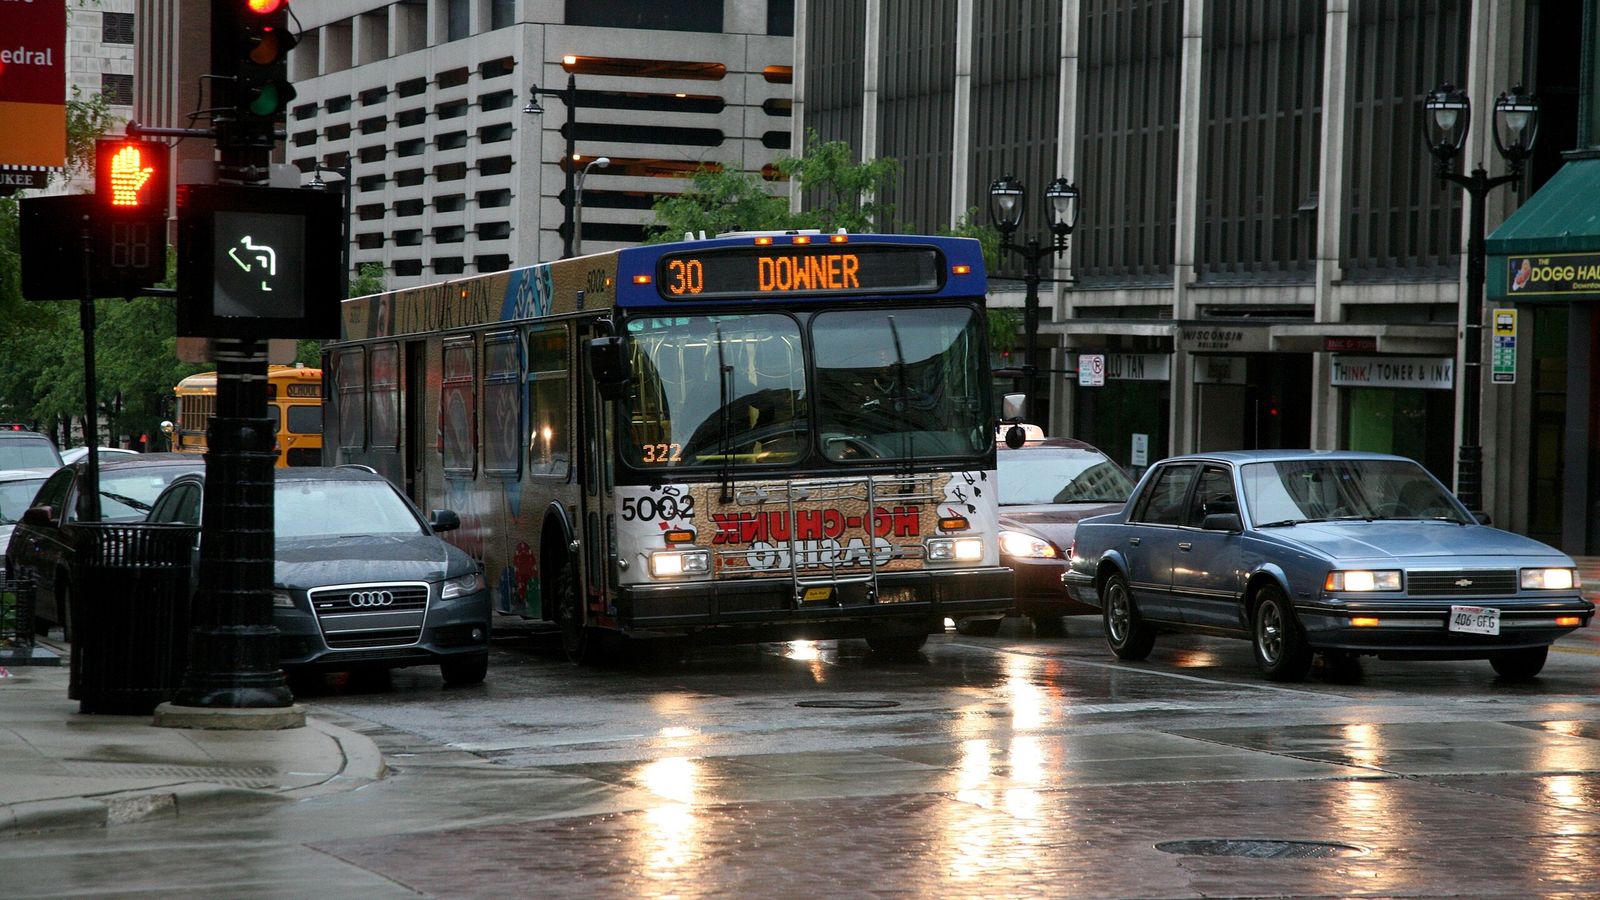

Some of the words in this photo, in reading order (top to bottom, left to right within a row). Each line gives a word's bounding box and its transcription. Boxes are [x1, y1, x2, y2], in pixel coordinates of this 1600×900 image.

[1, 47, 53, 66] edral
[669, 259, 703, 295] 30
[758, 254, 860, 292] DOWNER
[1531, 266, 1575, 282] DOGG
[1183, 329, 1243, 341] WISCONSIN
[1127, 355, 1144, 378] TAN
[1377, 363, 1413, 381] TONER
[1418, 364, 1425, 380] &
[1431, 364, 1451, 382] INK
[642, 443, 682, 463] 322
[621, 495, 696, 522] 5002
[1455, 613, 1495, 629] 406-GFG
